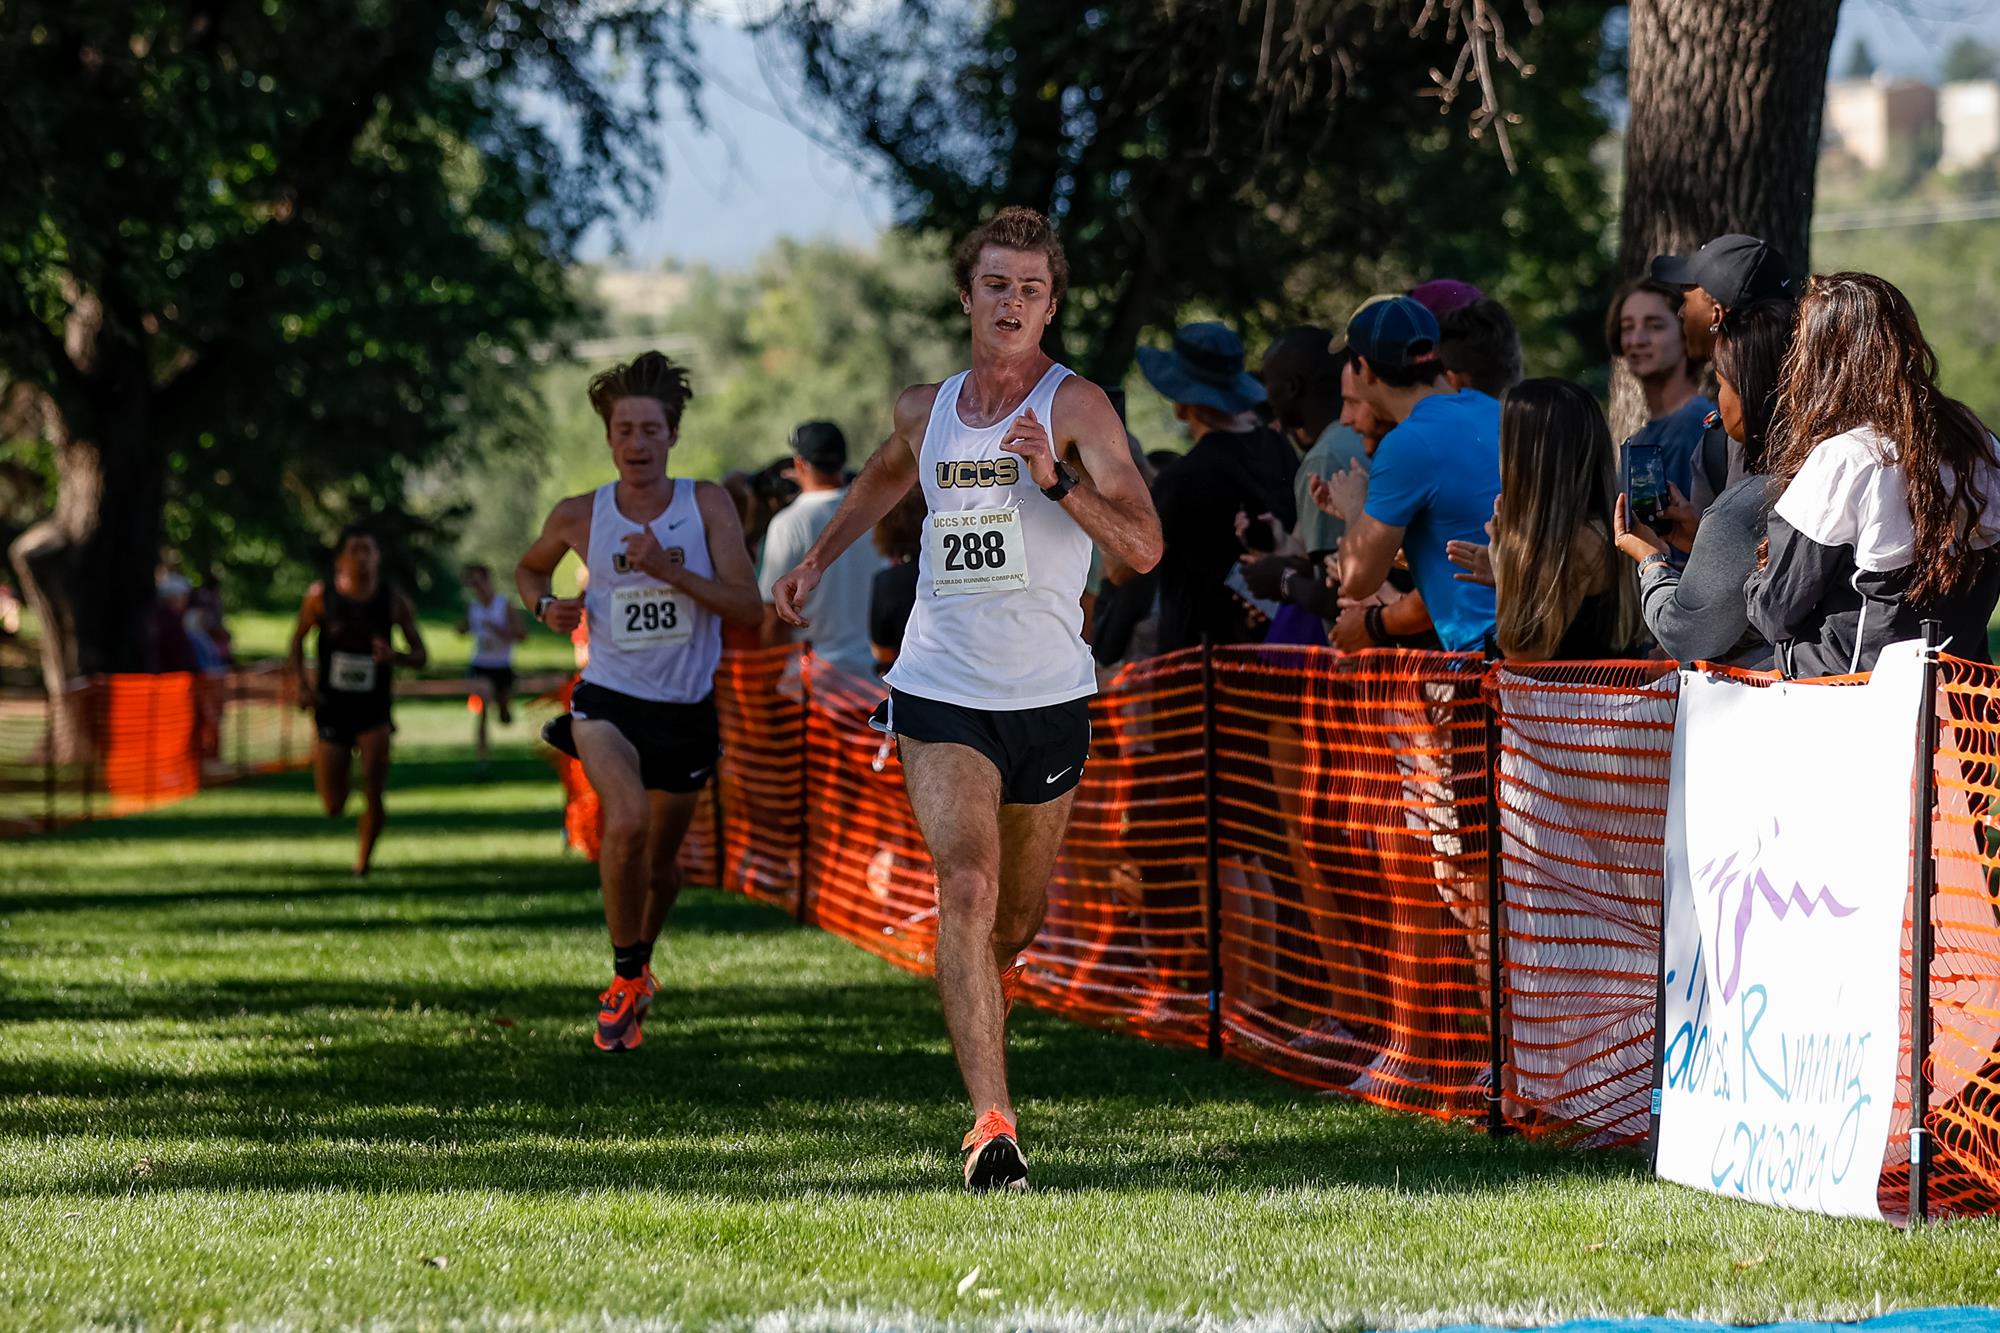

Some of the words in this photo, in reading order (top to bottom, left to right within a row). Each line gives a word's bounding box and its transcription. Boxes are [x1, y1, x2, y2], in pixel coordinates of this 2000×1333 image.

[936, 457, 1019, 488] UCCS
[933, 517, 958, 528] UCCS
[962, 515, 977, 526] XC
[980, 513, 1012, 525] OPEN
[943, 531, 1006, 571] 288
[991, 573, 1024, 582] COMPANY
[626, 602, 677, 632] 293
